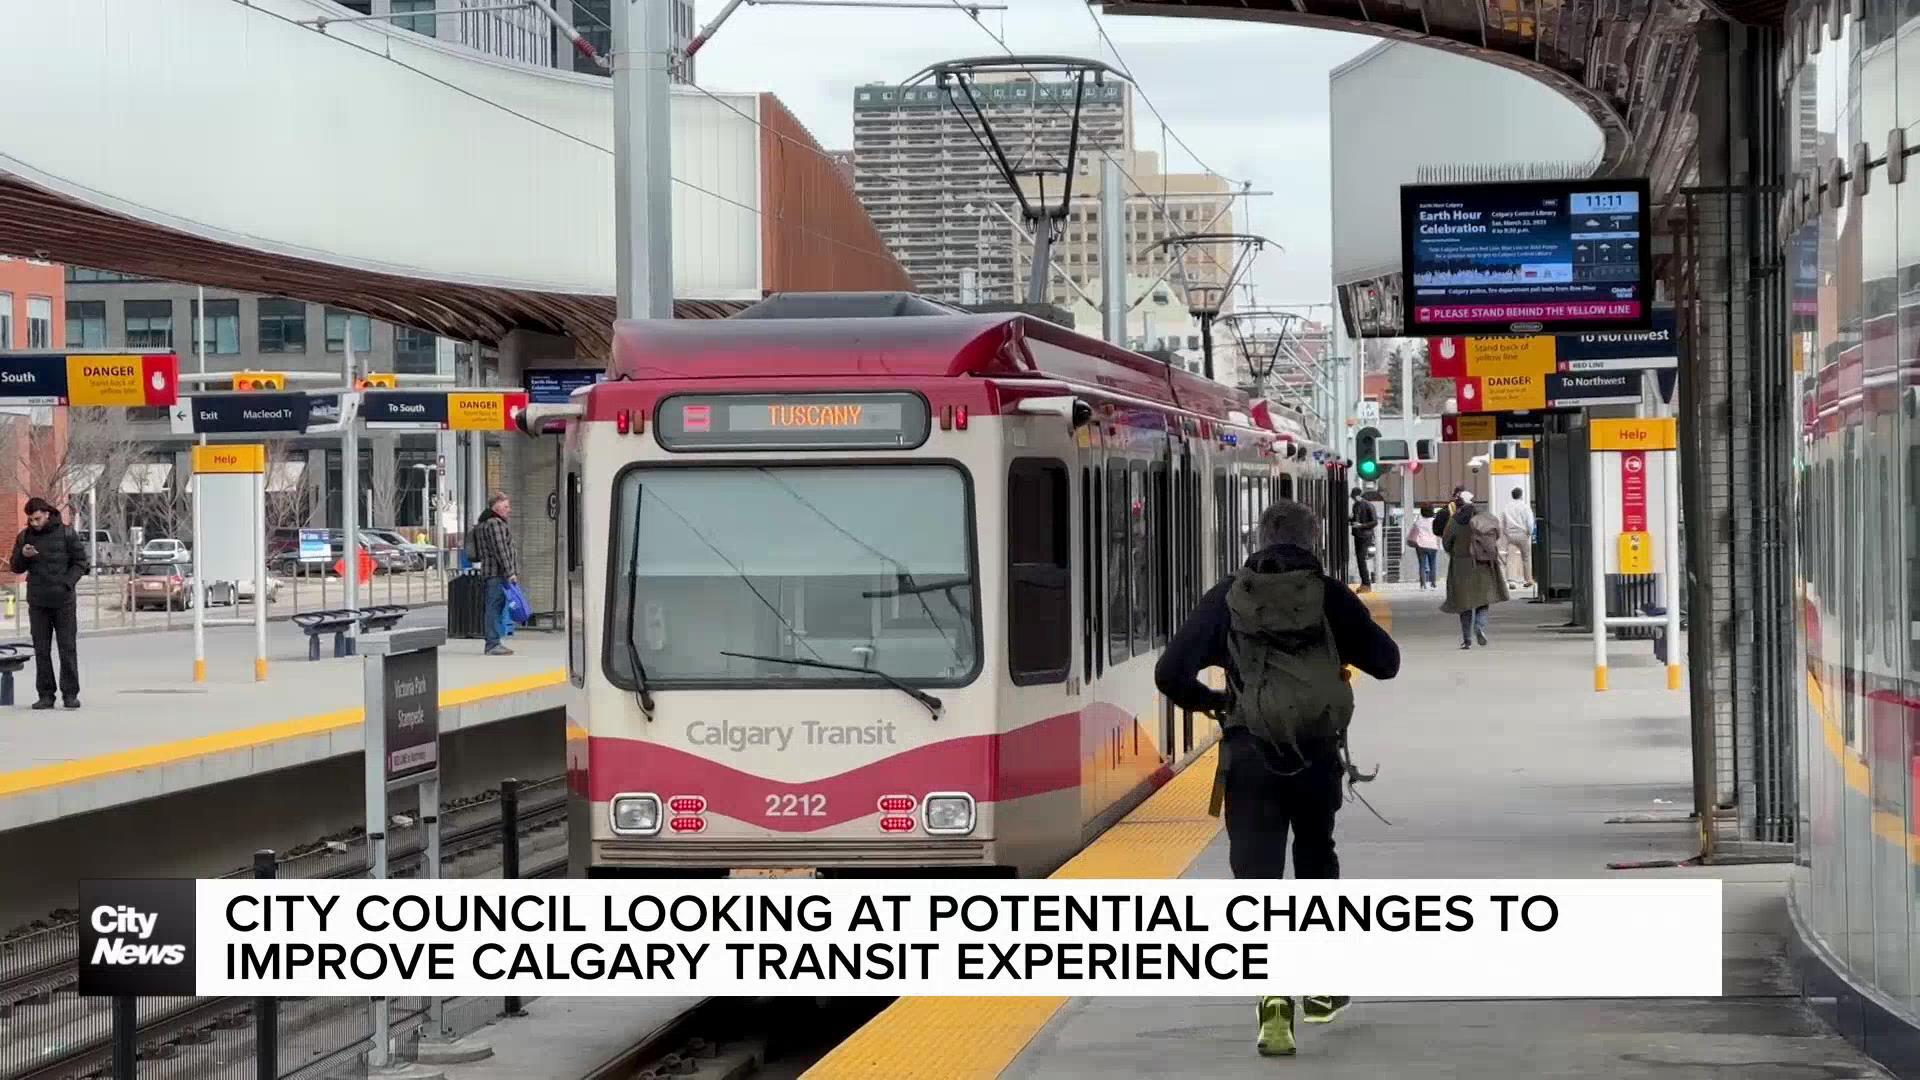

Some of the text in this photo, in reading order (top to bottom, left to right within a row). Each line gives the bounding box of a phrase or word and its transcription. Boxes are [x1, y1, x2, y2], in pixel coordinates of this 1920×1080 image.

[1586, 195, 1622, 207] 11:11
[1420, 210, 1482, 221] Earth Hour
[1420, 224, 1487, 235] Celebration
[1434, 304, 1632, 319] PLEASE STAND BEHIND THE YELLOW LINE
[1598, 329, 1669, 342] Northwest
[1475, 343, 1529, 352] Stand back of
[1475, 353, 1518, 364] yellow line
[1, 371, 36, 383] South
[83, 366, 135, 377] DANGER
[1488, 376, 1532, 386] DANGER
[1562, 375, 1626, 387] To Northwest
[388, 403, 425, 413] To South
[459, 400, 497, 410] DANGER
[200, 409, 293, 420] Exit Macleod Tr
[767, 404, 863, 428] TUSCANY
[1619, 430, 1647, 441] Help
[213, 455, 238, 465] Help
[394, 672, 427, 699] Victoria Park
[398, 703, 425, 730] Stampede
[686, 720, 896, 752] Calgary Transit
[765, 794, 827, 818] 2212
